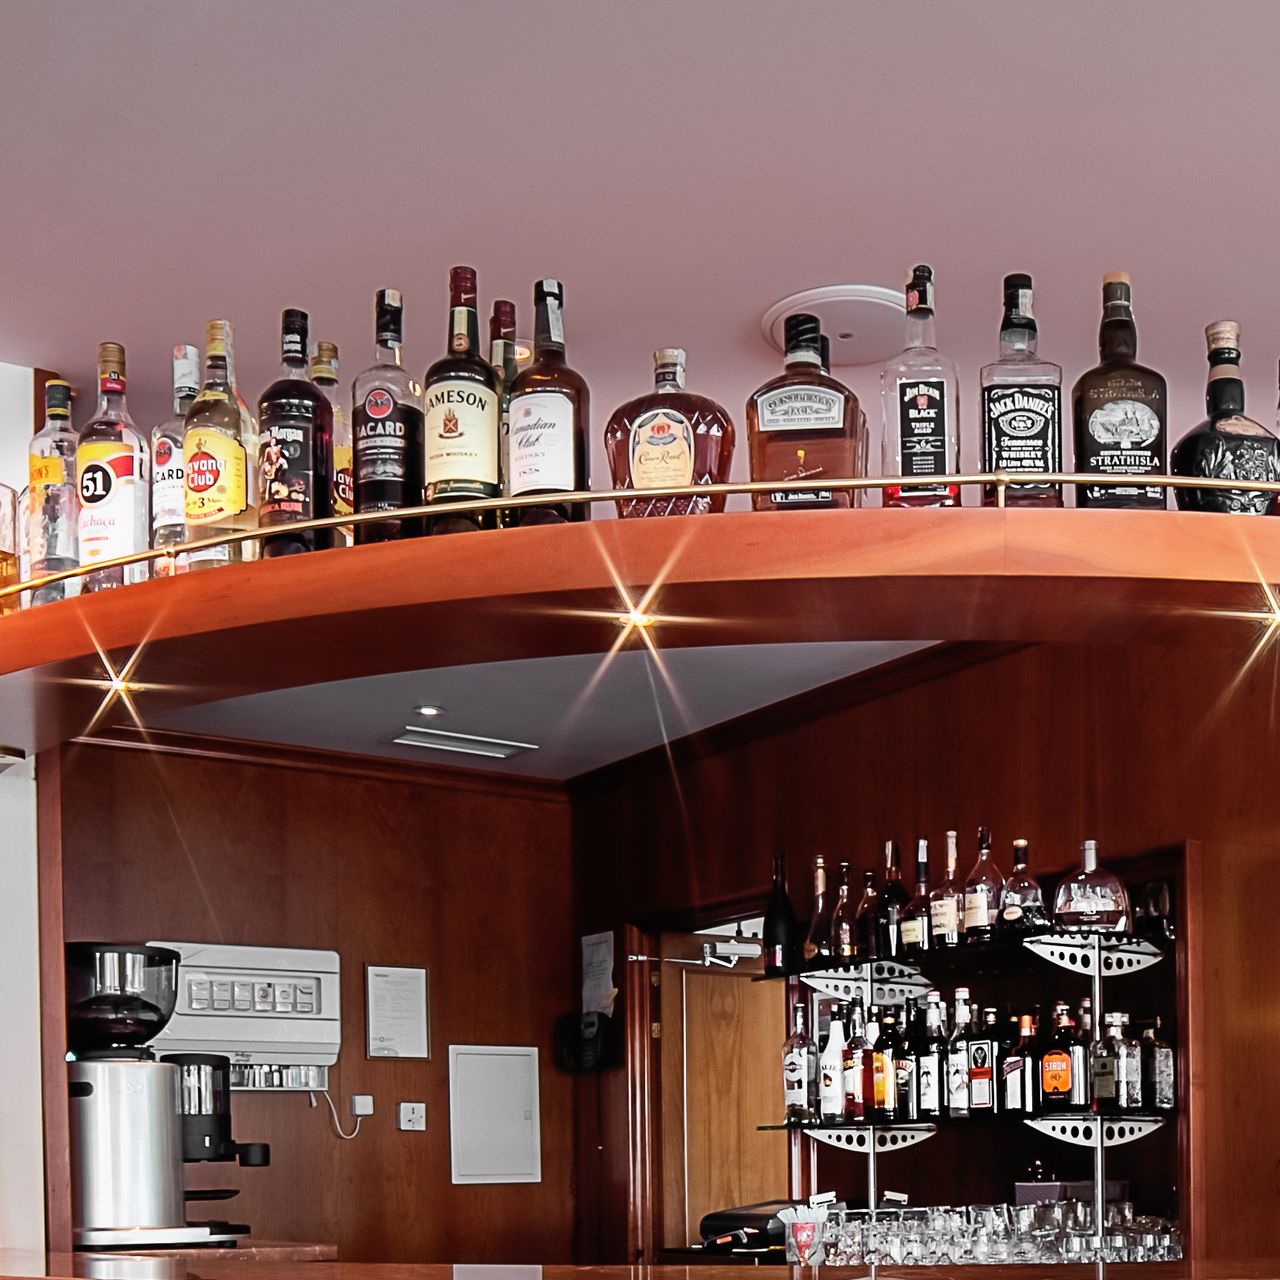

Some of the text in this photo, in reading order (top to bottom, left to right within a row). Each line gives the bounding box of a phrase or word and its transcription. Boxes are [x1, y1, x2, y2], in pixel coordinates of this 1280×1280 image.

[919, 384, 940, 400] BEAM
[424, 390, 488, 416] JAMESON
[767, 393, 836, 410] GENTLEMAN
[989, 397, 1015, 418] JACK
[787, 406, 814, 416] JACK
[909, 409, 936, 418] BLACK
[1090, 456, 1160, 467] STRATHISLA
[82, 471, 106, 497] 51
[188, 470, 216, 488] Club
[198, 498, 205, 508] 3
[1045, 1061, 1066, 1071] STROH
